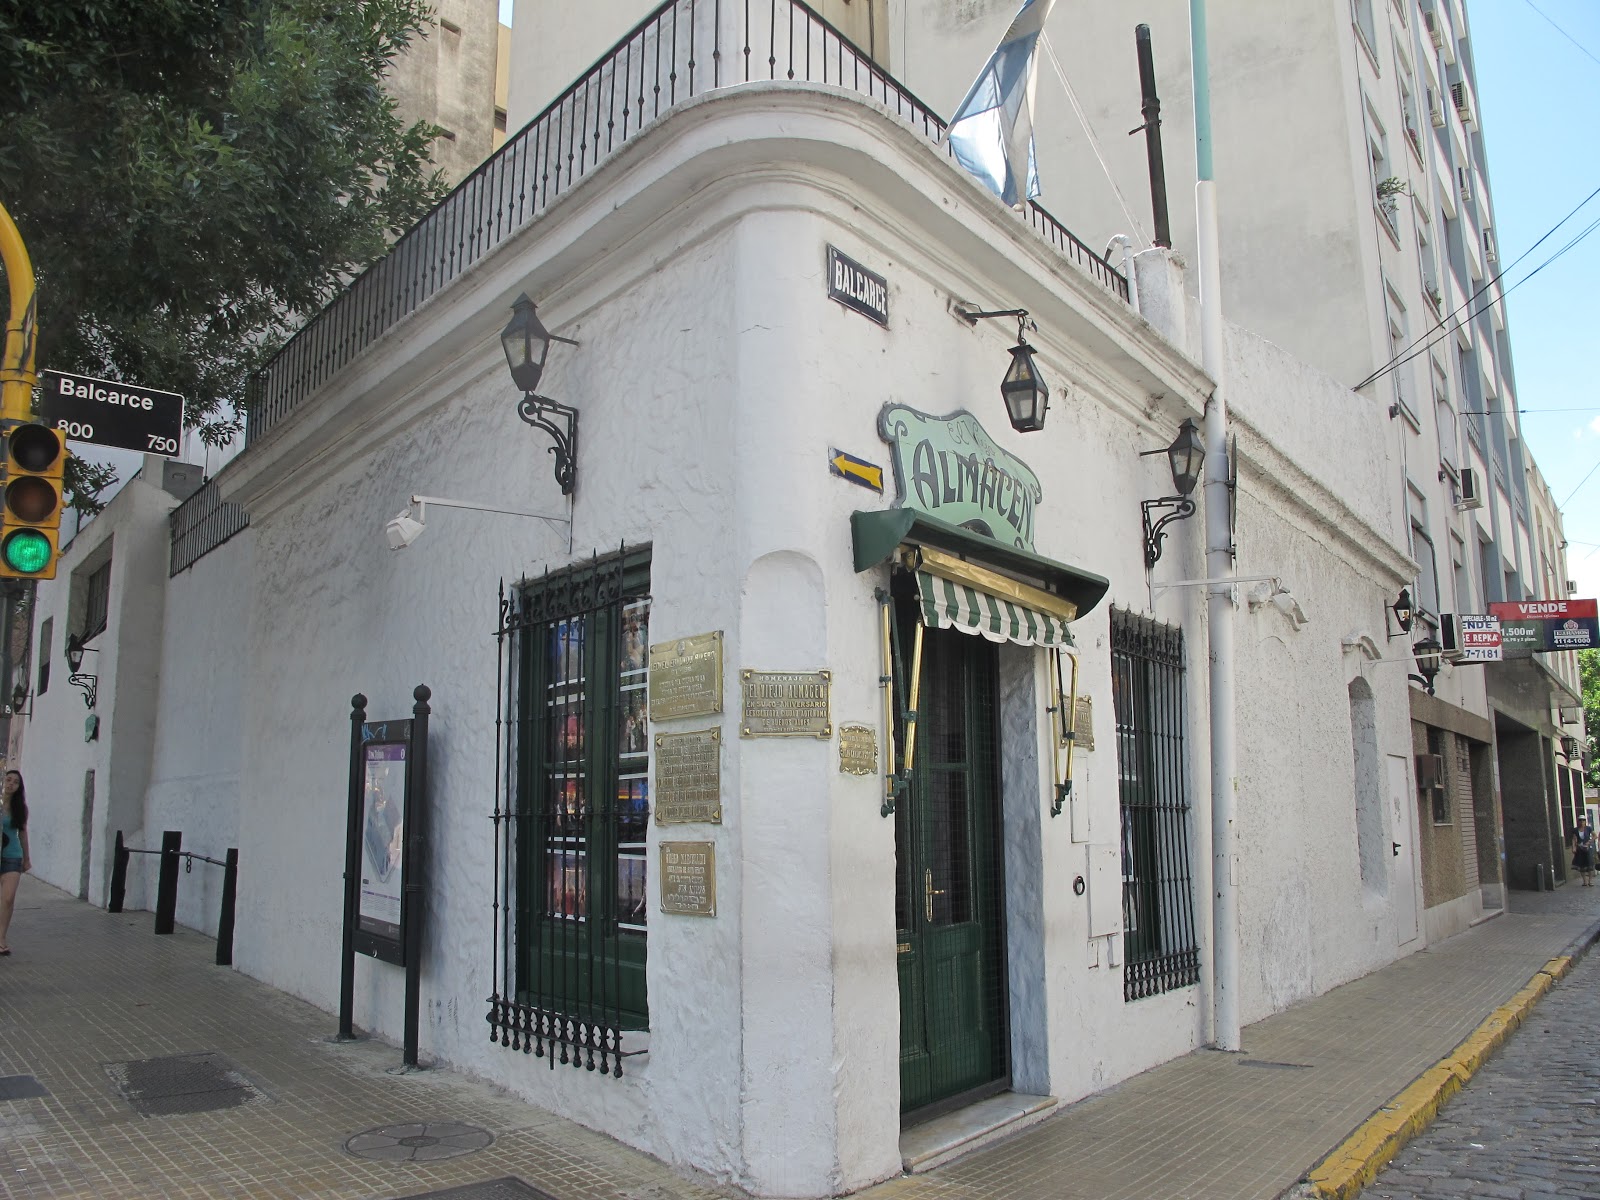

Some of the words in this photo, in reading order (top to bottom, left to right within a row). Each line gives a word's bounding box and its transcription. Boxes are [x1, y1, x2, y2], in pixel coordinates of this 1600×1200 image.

[834, 260, 887, 316] BALCARCE
[60, 378, 154, 411] Balcarce
[57, 419, 94, 439] 800
[147, 434, 177, 453] 750
[911, 438, 1033, 544] ALMACEN
[1518, 603, 1567, 613] VENDE
[1462, 622, 1493, 630] ENDE
[1473, 633, 1498, 643] REPKA
[1465, 650, 1498, 659] 7-7181
[749, 684, 758, 698] EL
[760, 684, 783, 698] VIEJO
